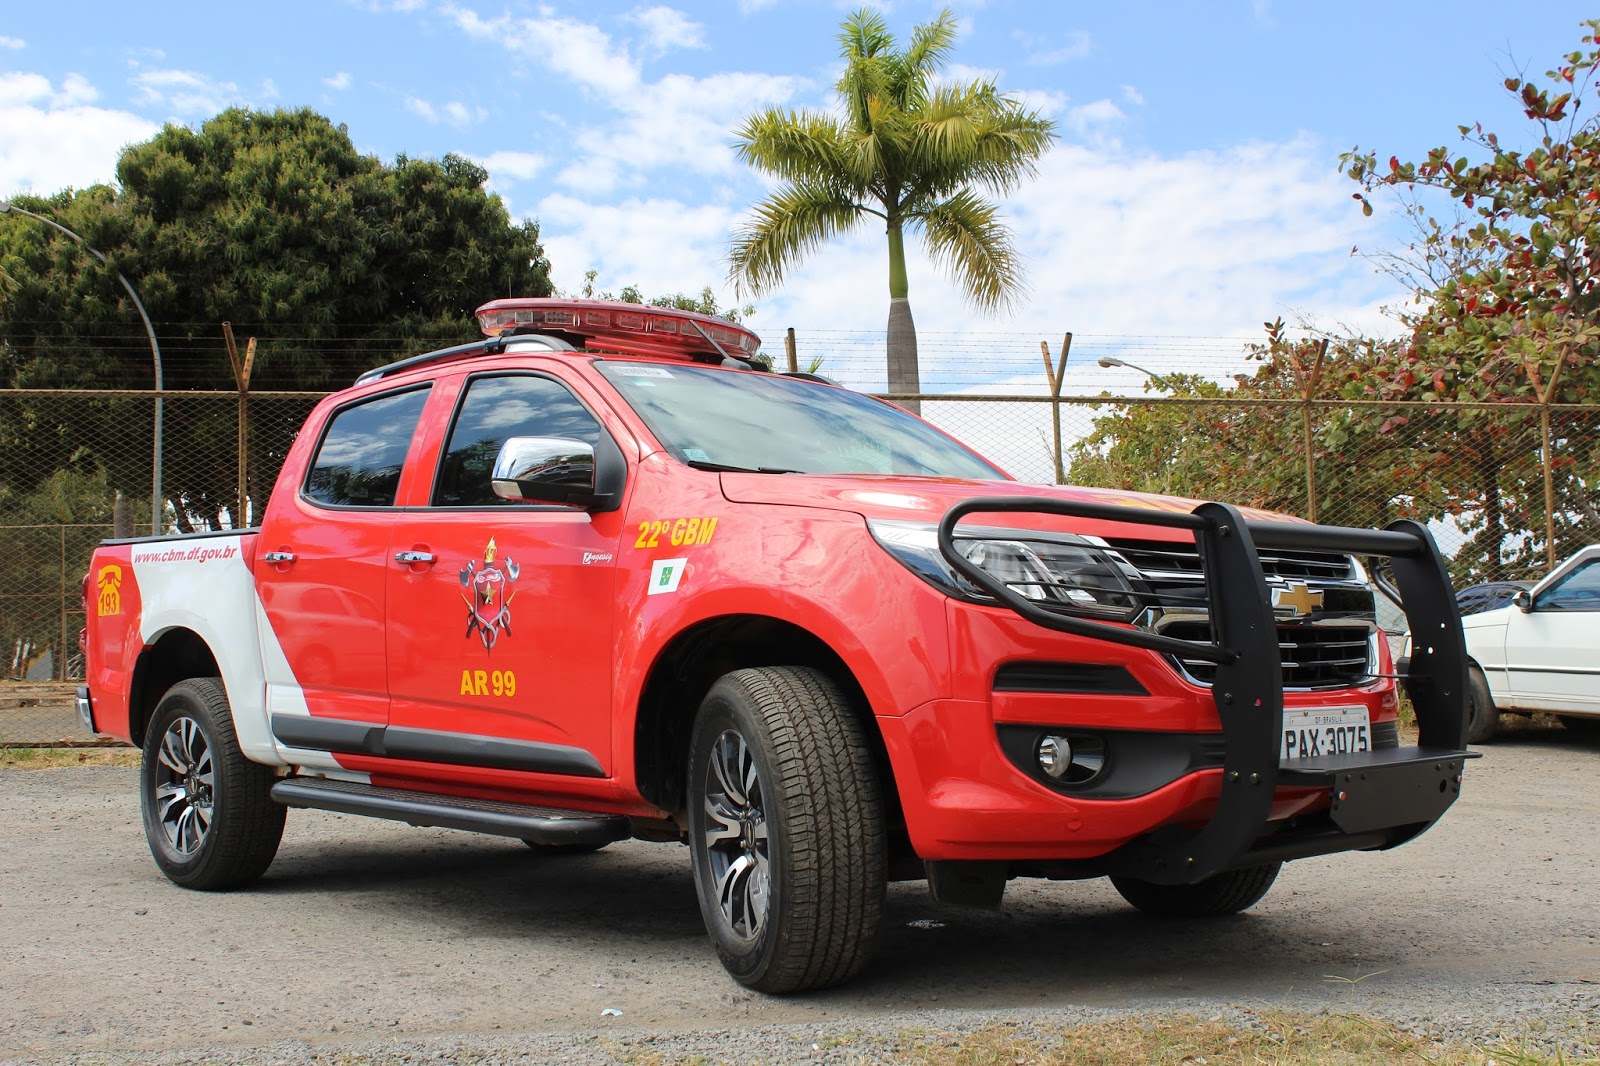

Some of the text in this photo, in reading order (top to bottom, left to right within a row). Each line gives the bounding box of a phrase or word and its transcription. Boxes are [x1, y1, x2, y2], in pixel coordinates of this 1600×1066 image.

[670, 517, 718, 546] GBM
[134, 545, 238, 563] www.cbm.df.gov.br
[100, 592, 117, 615] 193
[460, 670, 516, 697] AR 99
